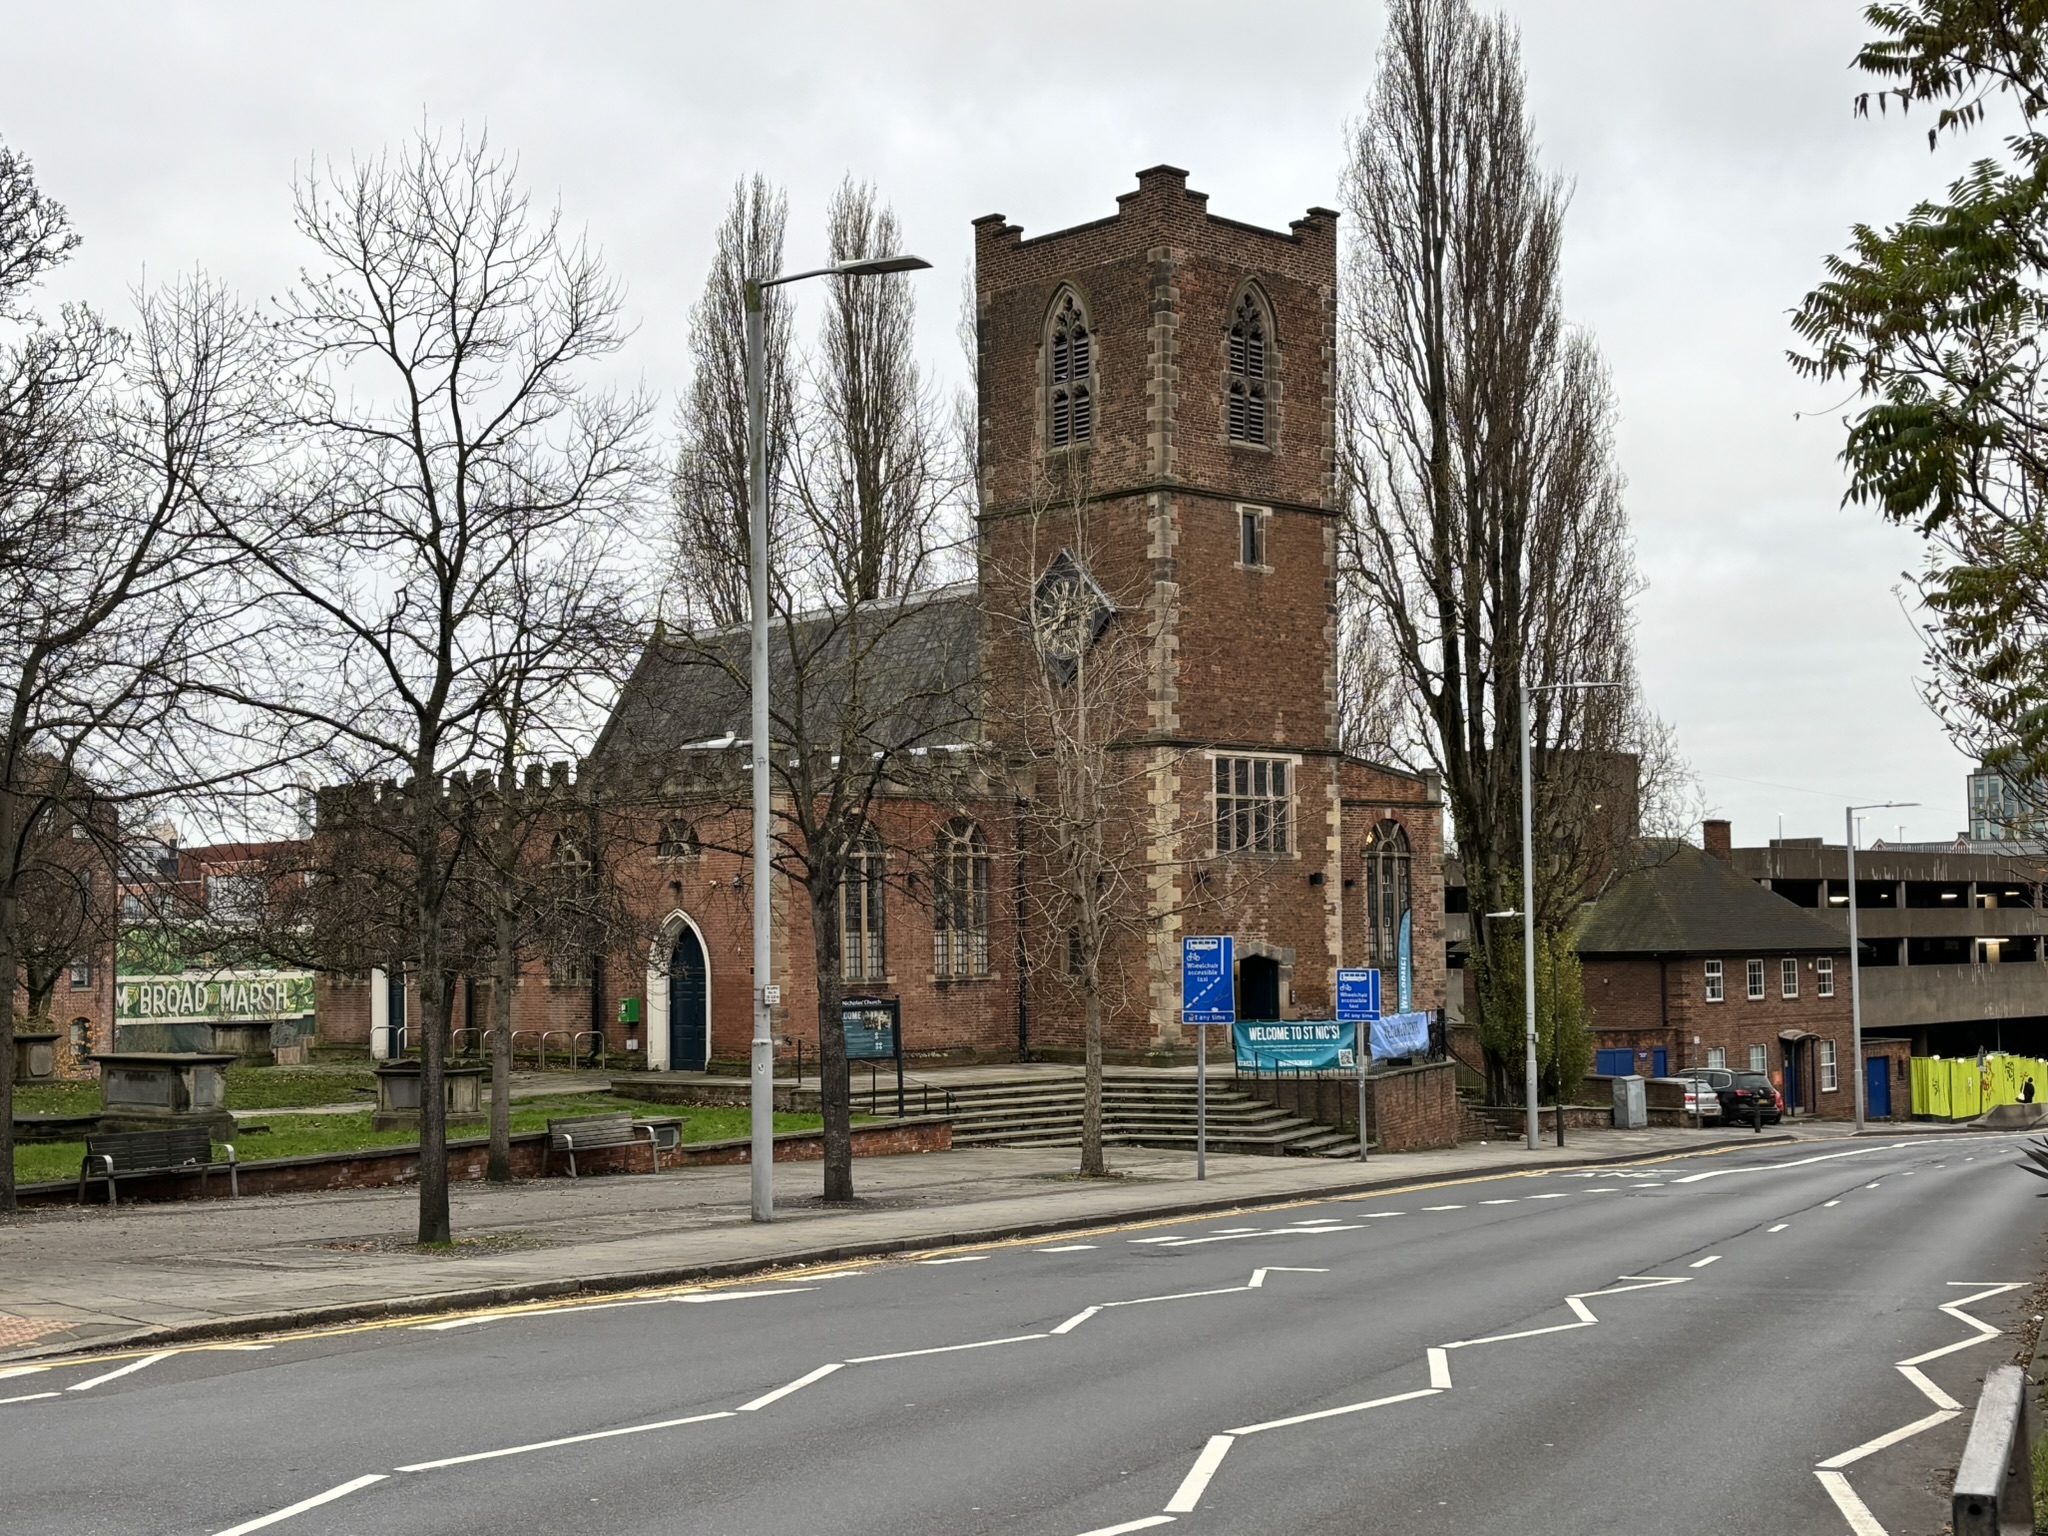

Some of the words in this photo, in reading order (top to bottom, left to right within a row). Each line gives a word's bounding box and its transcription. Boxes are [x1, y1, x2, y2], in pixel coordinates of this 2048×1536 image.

[140, 985, 208, 1015] BROAD
[220, 983, 288, 1012] MARSH
[1249, 1027, 1290, 1040] WELCOME
[1291, 1027, 1301, 1039] TO
[1303, 1026, 1313, 1039] ST
[1315, 1025, 1340, 1039] NIC'S!
